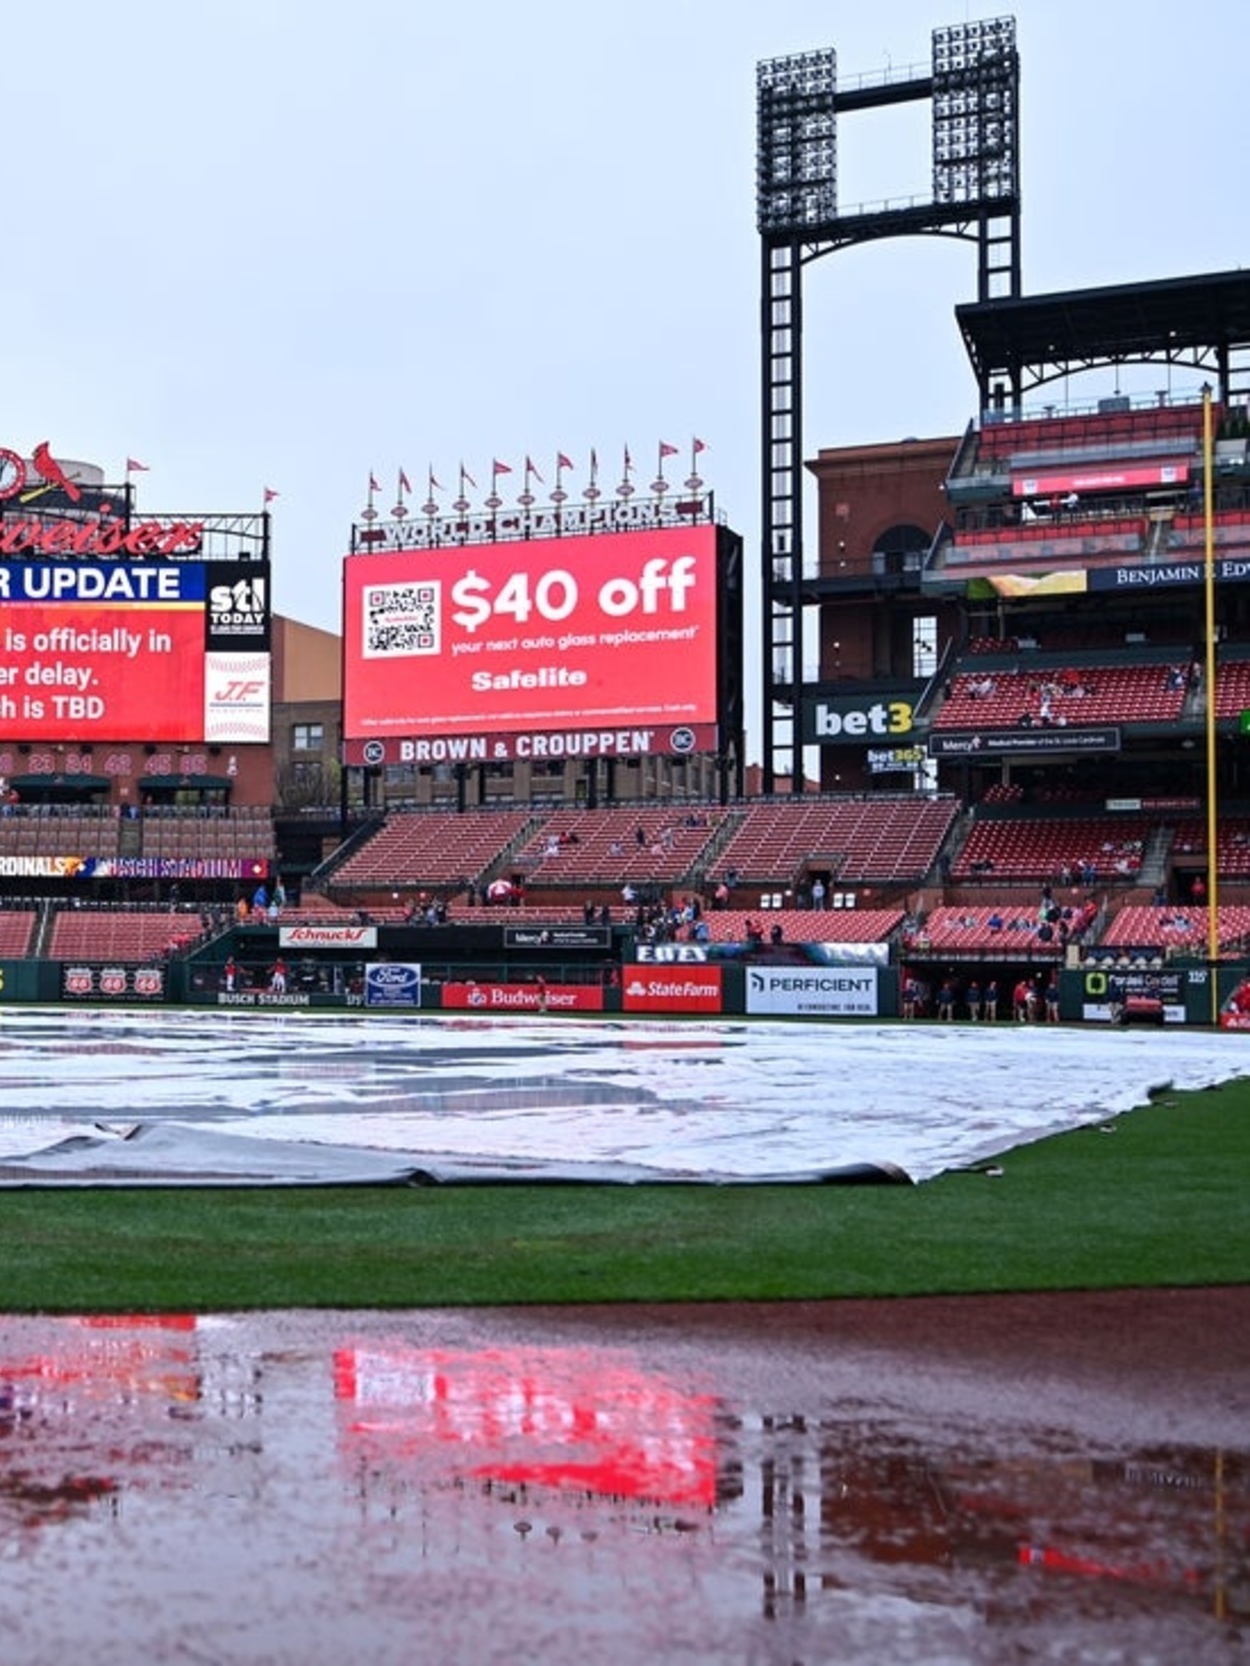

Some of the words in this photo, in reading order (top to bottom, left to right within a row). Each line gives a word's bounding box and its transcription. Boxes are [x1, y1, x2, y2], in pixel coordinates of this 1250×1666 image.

[384, 518, 488, 545] WORLD
[495, 502, 676, 538] CHAMPIONS
[24, 567, 181, 599] UPDATE
[1117, 566, 1199, 585] BENJAMIN
[1222, 562, 1250, 578] ED
[210, 578, 265, 613] stl
[451, 569, 578, 633] $40
[598, 556, 697, 617] off
[210, 613, 265, 624] TODAY
[5, 628, 27, 652] is
[33, 628, 142, 658] officially
[149, 629, 172, 652] in
[451, 640, 482, 657] your
[486, 637, 518, 650] next
[521, 635, 555, 649] auto
[558, 632, 596, 650] glass
[25, 661, 99, 691] delay.
[472, 667, 588, 691] Safelite
[23, 695, 45, 719] is
[52, 695, 105, 719] TBD
[400, 738, 487, 761] BROWN
[494, 742, 508, 758] &
[516, 731, 650, 757] CROUPPEN
[868, 750, 922, 763] bet365
[288, 928, 368, 941] Schnucks
[376, 966, 409, 985] Ford
[770, 978, 873, 992] PERFICIENT
[218, 993, 255, 1005] BUSCH
[258, 993, 310, 1006] STADIUM
